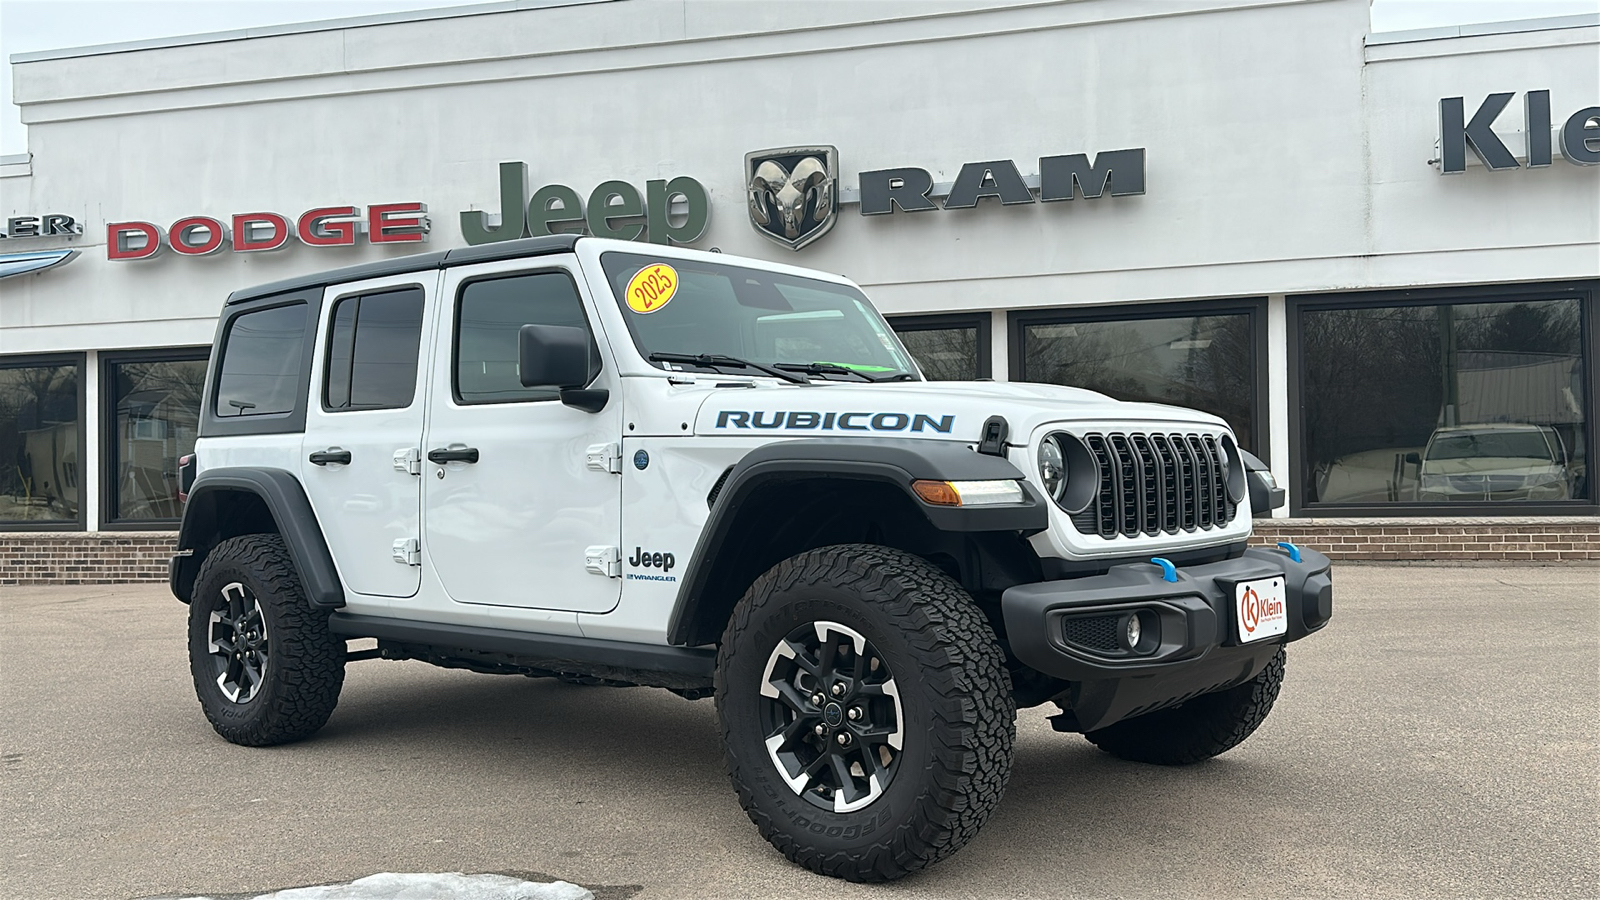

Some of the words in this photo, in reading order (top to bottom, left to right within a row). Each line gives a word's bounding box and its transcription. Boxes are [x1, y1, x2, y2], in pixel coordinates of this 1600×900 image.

[858, 148, 1146, 215] RAM
[460, 161, 711, 246] Jeep
[0, 213, 75, 238] ER
[106, 202, 426, 260] DODGE
[634, 267, 672, 309] 2025
[715, 410, 956, 433] RUBICON
[629, 547, 675, 572] Jeep
[633, 574, 676, 582] WRANGLER
[1261, 597, 1282, 617] Klein
